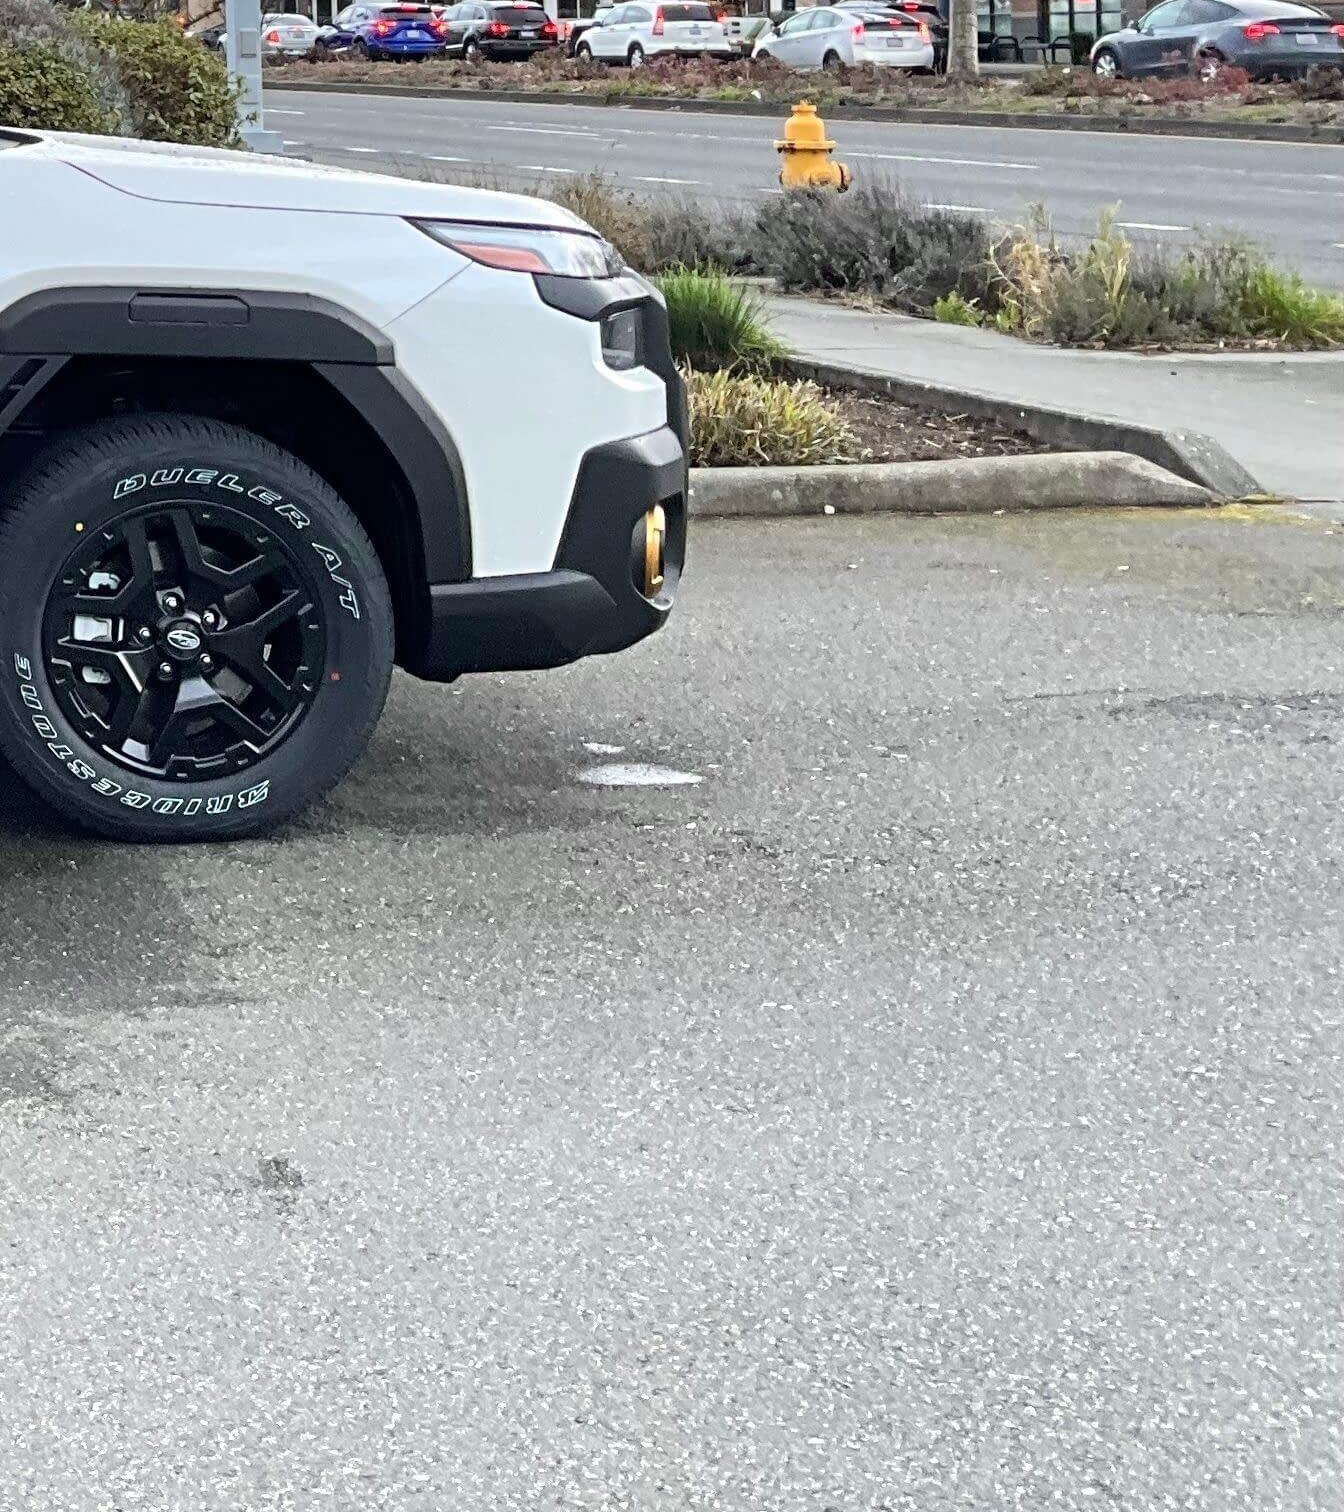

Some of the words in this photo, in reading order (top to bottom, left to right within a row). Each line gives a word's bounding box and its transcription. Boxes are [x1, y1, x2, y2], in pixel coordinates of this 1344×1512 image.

[113, 467, 311, 530] DUELER
[311, 541, 360, 619] A/T
[13, 652, 271, 816] BRIDGESTONE
